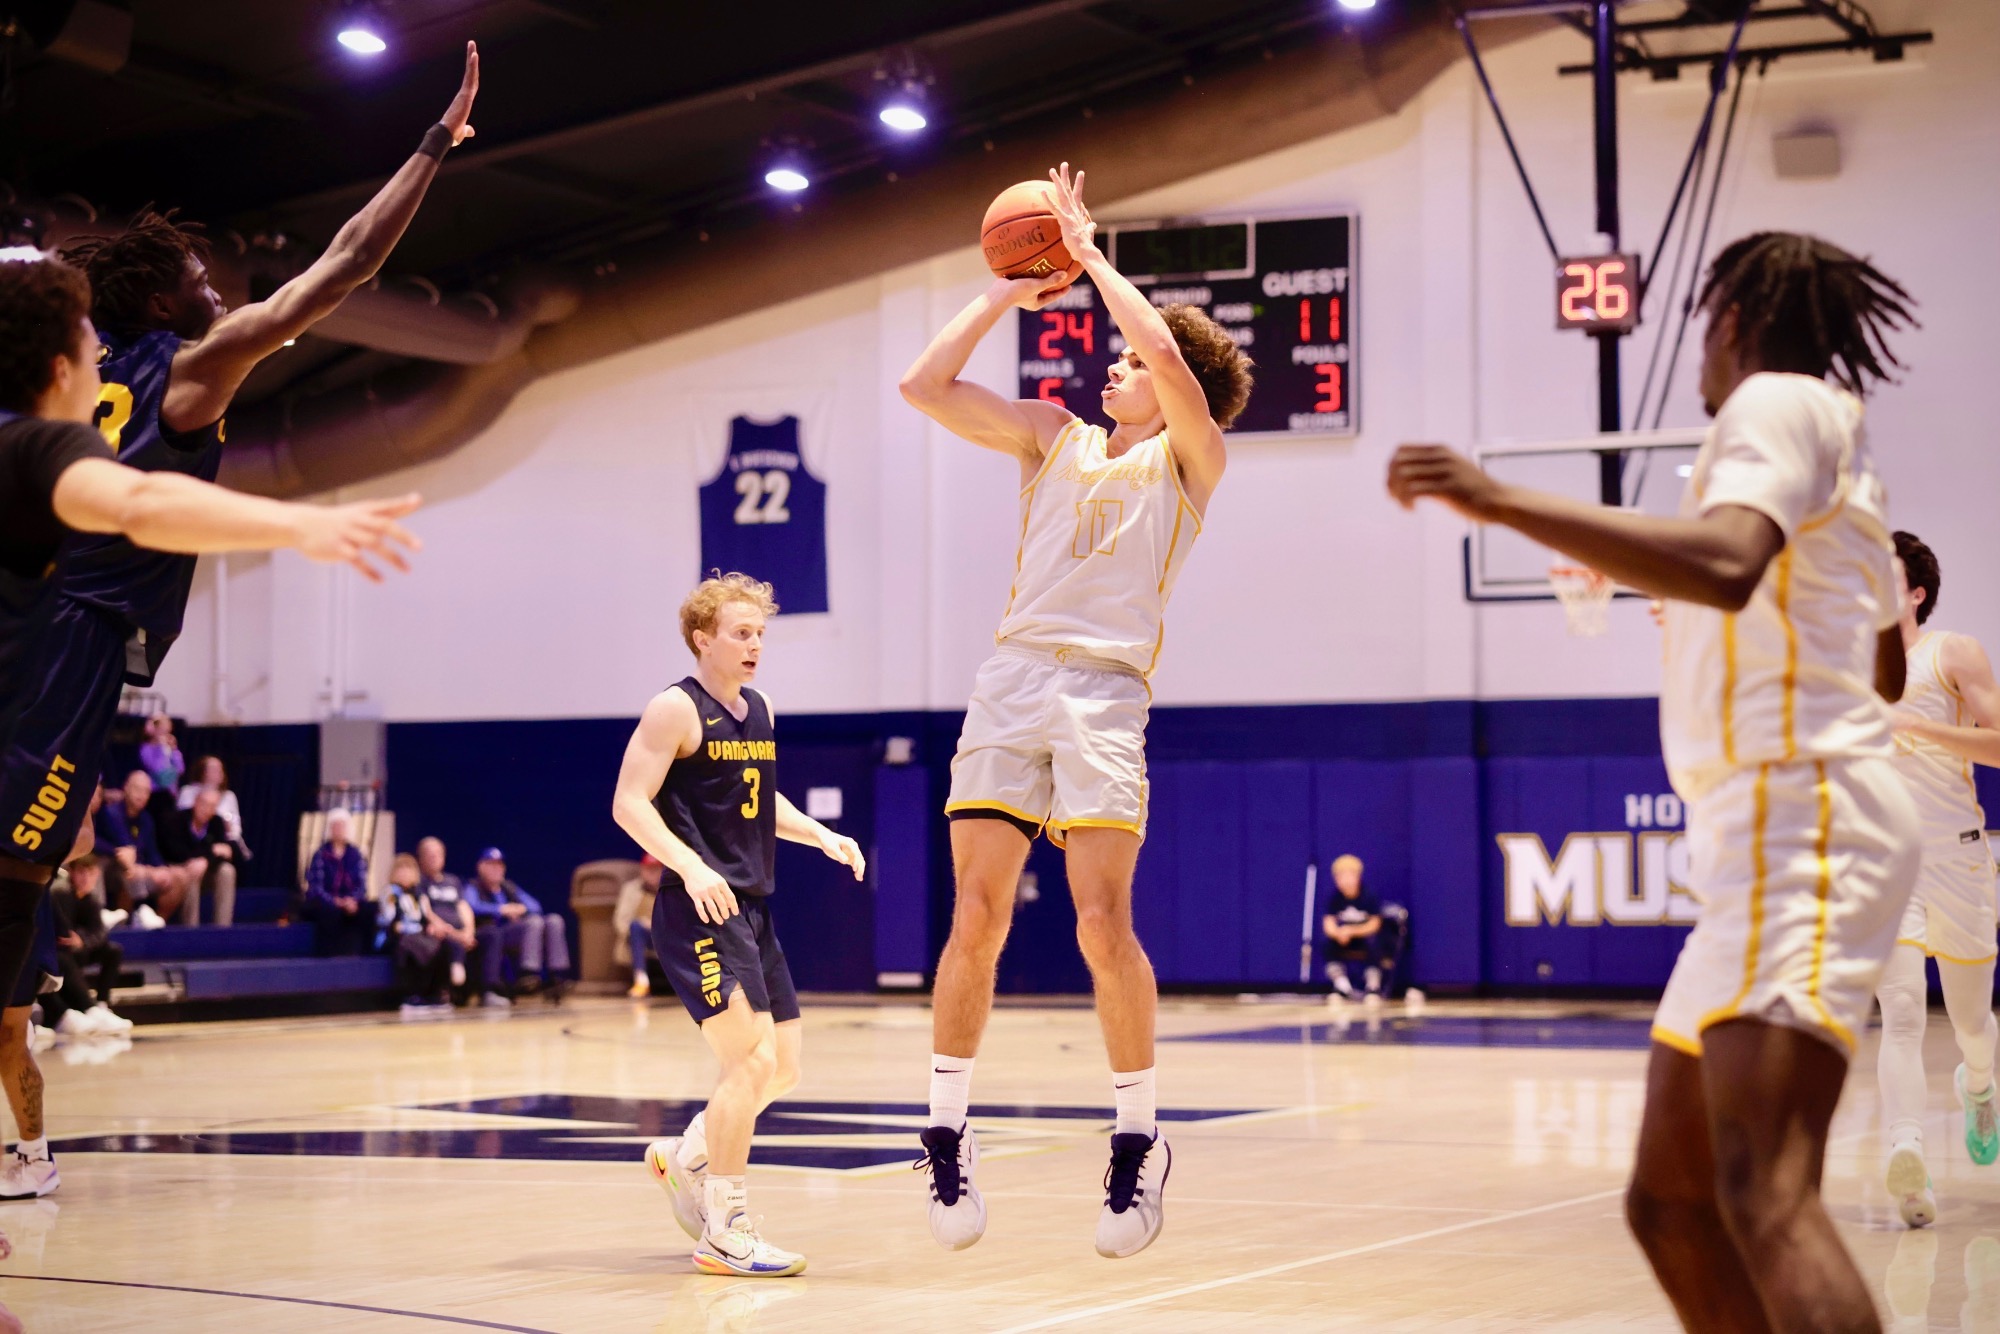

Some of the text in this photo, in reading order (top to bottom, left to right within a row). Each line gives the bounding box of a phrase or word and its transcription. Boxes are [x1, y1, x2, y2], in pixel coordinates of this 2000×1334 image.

[1262, 267, 1348, 297] GUEST
[1562, 261, 1628, 320] 26
[1039, 311, 1094, 359] 24
[1300, 297, 1341, 342] 11
[1314, 363, 1341, 413] 3
[733, 469, 791, 525] 22
[1054, 456, 1163, 491] Musangs
[1072, 499, 1124, 560] 11
[12, 754, 76, 851] LIONS
[741, 767, 760, 819] 3
[1624, 793, 1689, 827] HO
[694, 937, 722, 1007] LIONS
